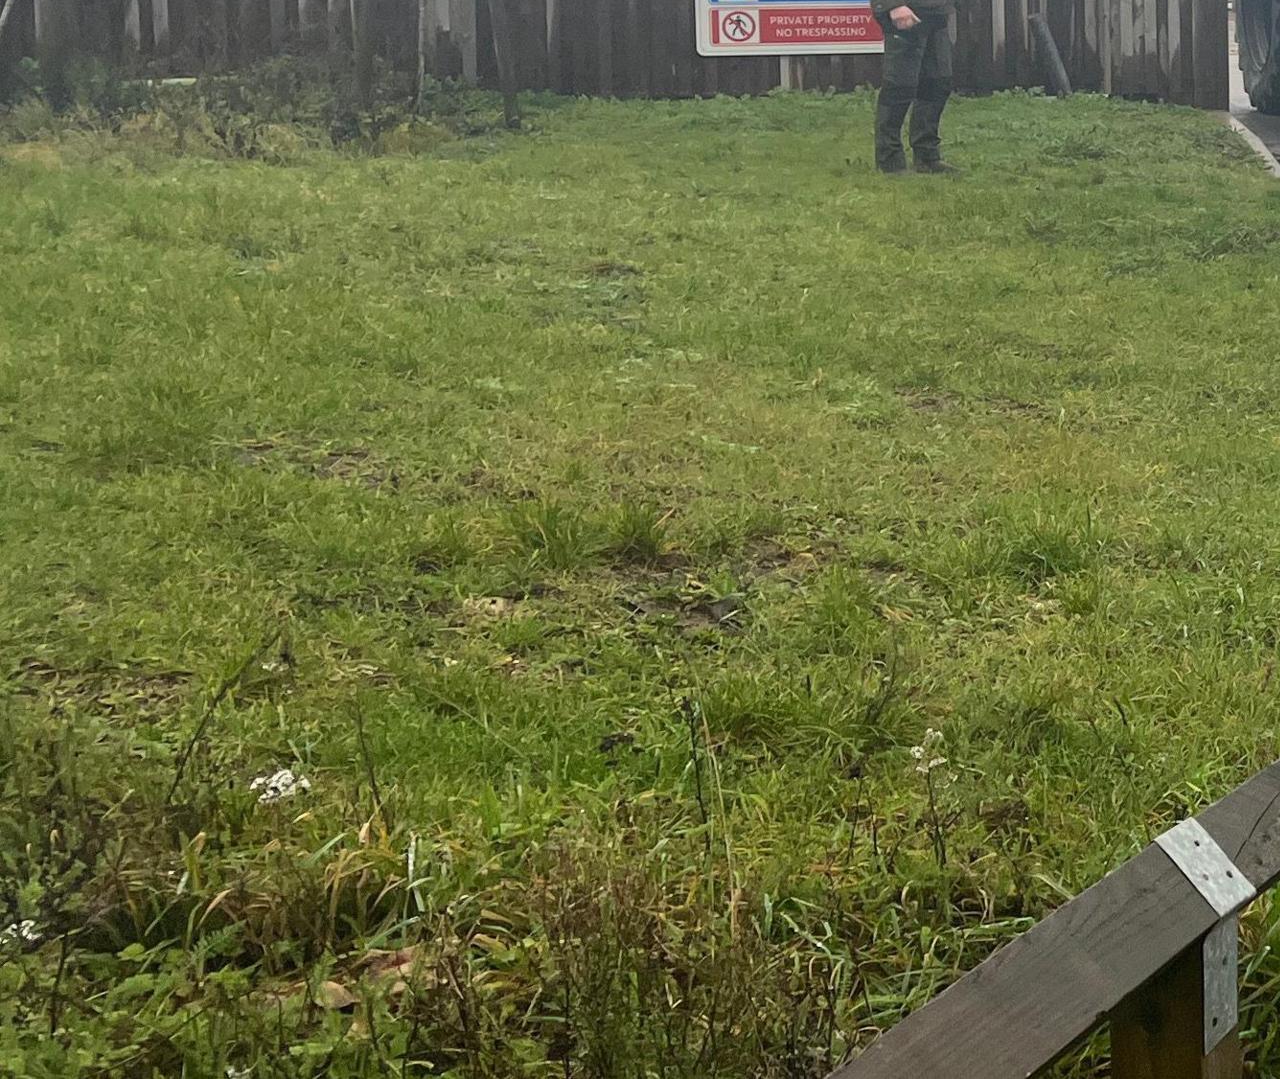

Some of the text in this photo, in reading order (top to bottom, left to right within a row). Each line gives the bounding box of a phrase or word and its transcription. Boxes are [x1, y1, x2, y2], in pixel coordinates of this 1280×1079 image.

[769, 15, 872, 25] PRIVATE PROPERTY
[775, 27, 867, 37] NO TRESPASSING
